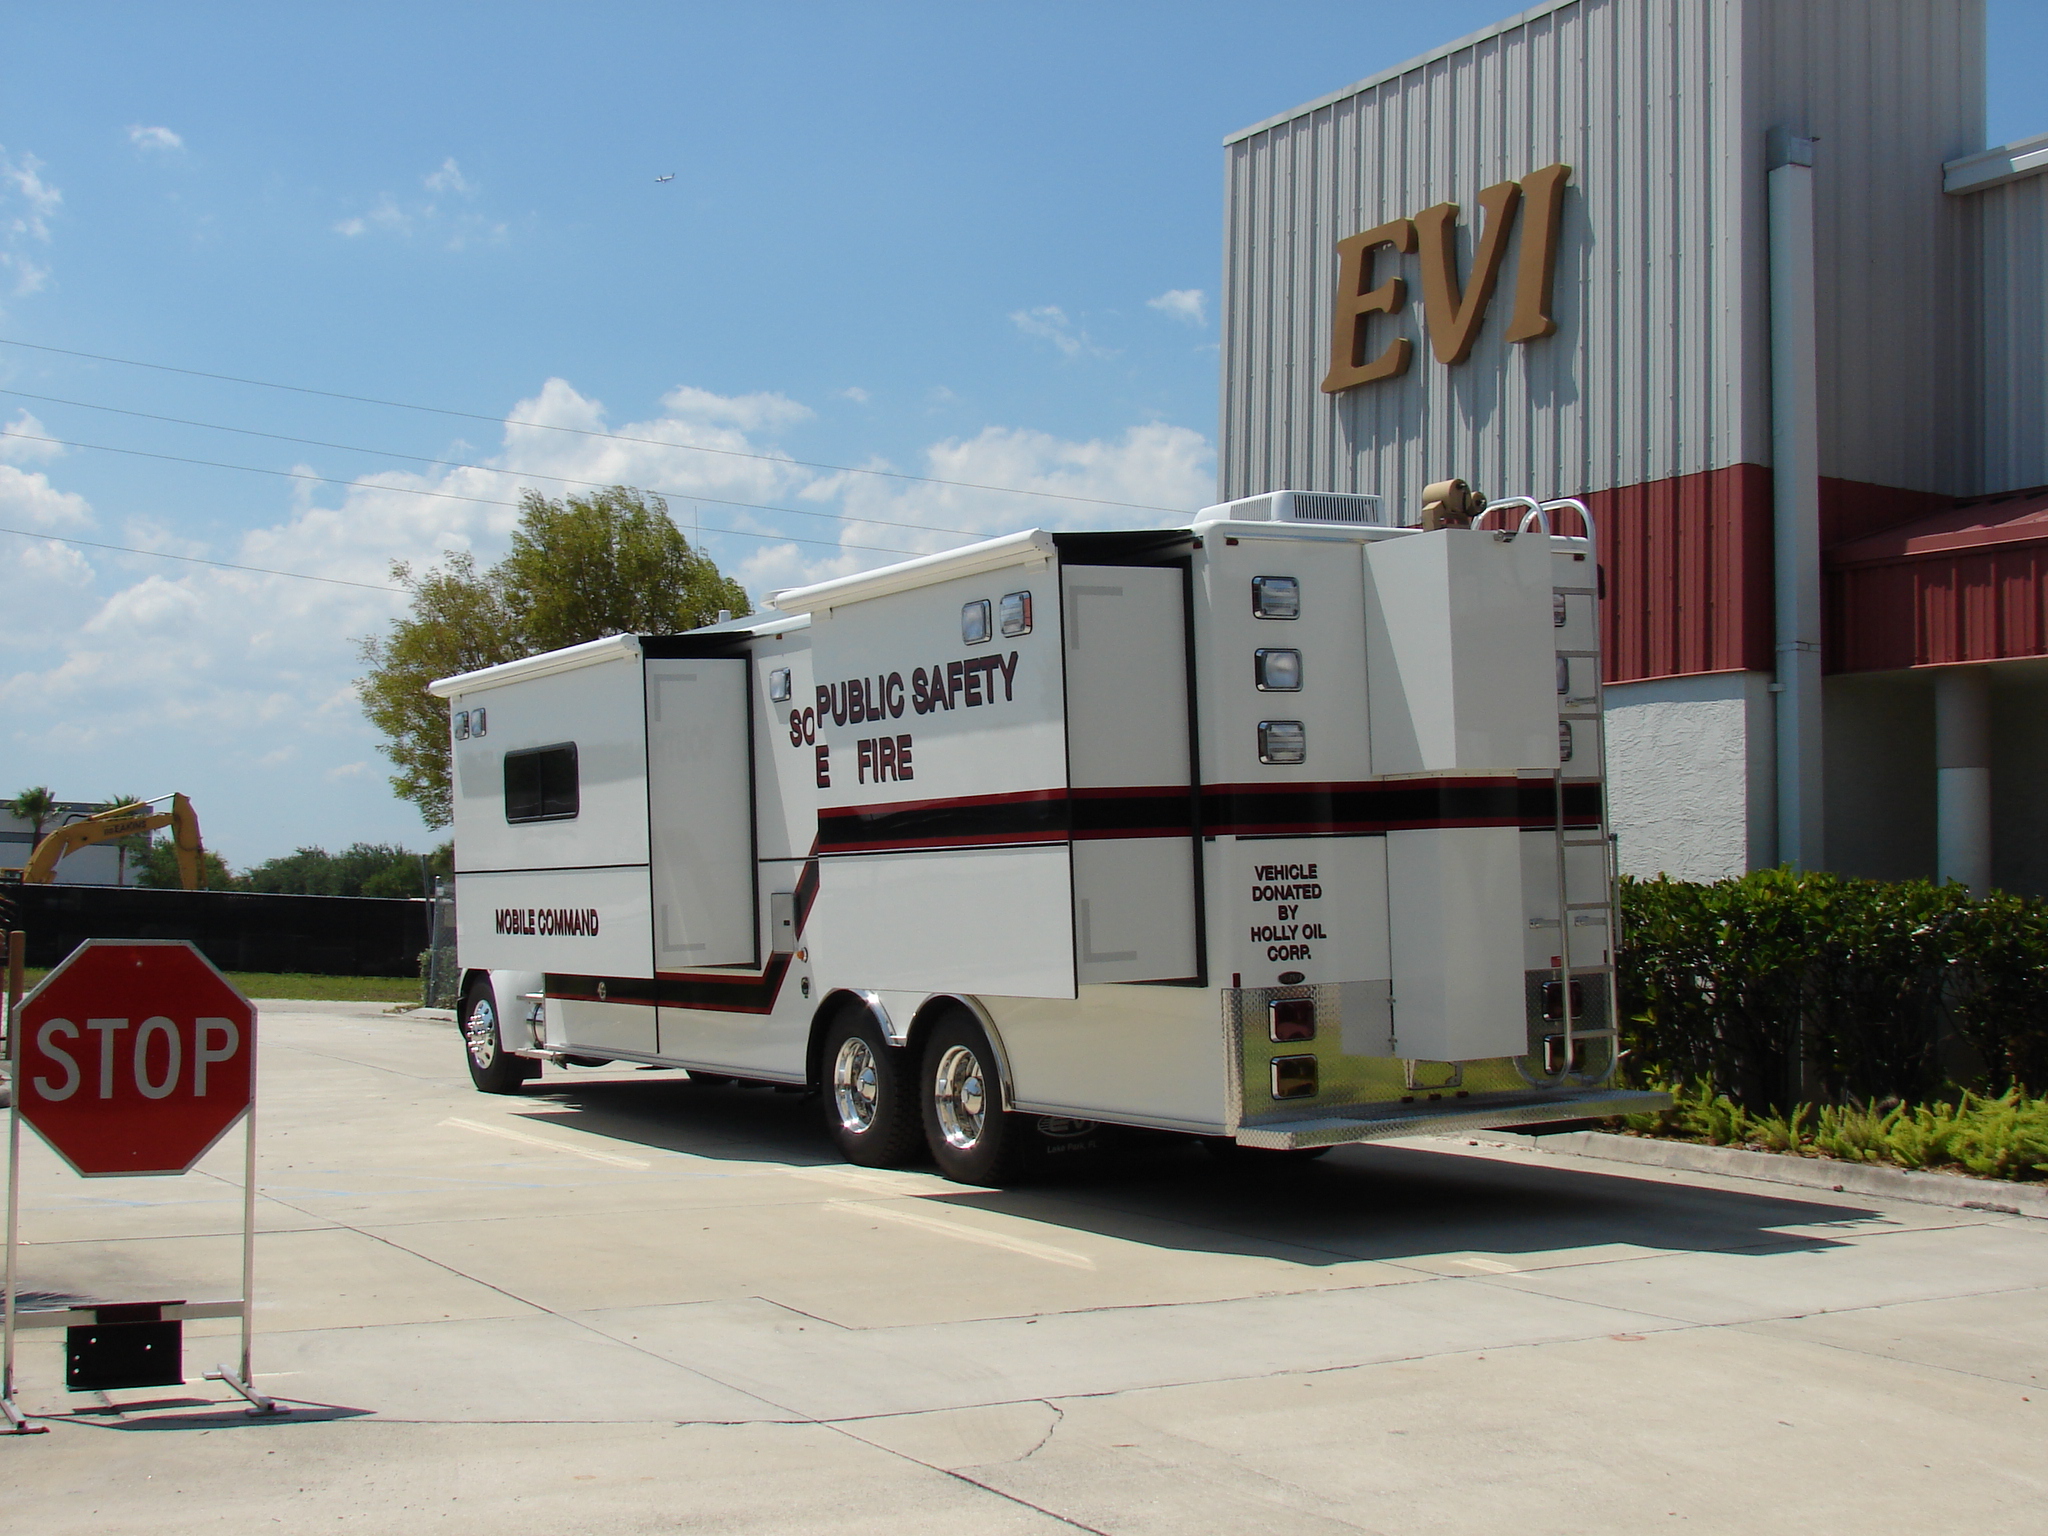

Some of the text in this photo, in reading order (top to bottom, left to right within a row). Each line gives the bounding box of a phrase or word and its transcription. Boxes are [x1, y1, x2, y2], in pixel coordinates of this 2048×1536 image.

[1321, 163, 1572, 393] EVI
[816, 671, 905, 729] PUBLIC
[912, 651, 1019, 715] SAFETY
[815, 733, 914, 788] E FIRE
[1254, 863, 1318, 881] VEHICLE
[1252, 884, 1322, 901] DONATED
[1278, 904, 1299, 920] BY
[495, 908, 599, 937] MOBILE COMMAND
[1250, 923, 1328, 942] HOLLY OIL
[1267, 944, 1312, 962] CORP.
[33, 1015, 240, 1102] STOP
[1046, 1145, 1066, 1154] Lake
